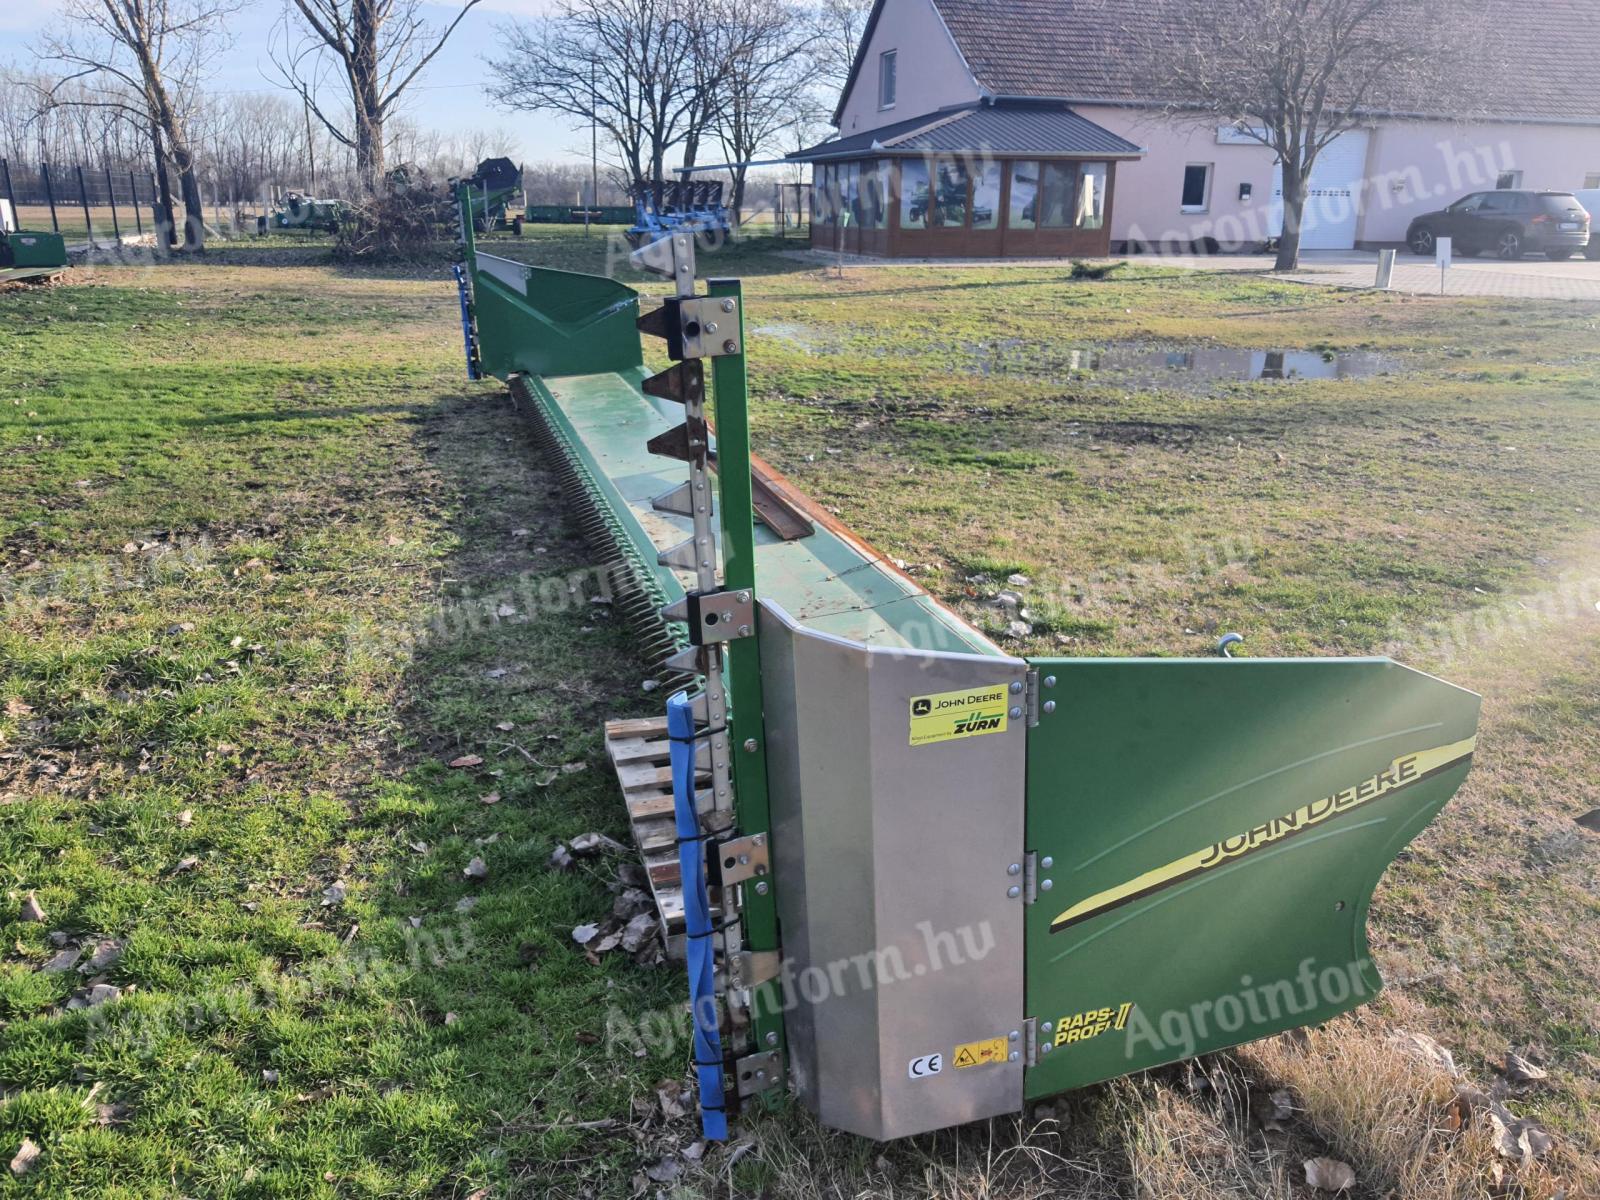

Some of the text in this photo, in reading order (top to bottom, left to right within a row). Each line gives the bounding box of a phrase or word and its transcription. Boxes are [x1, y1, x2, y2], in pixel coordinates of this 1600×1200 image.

[935, 692, 1003, 710] JOHN DEERE
[1200, 755, 1418, 865] JOHN DEERE
